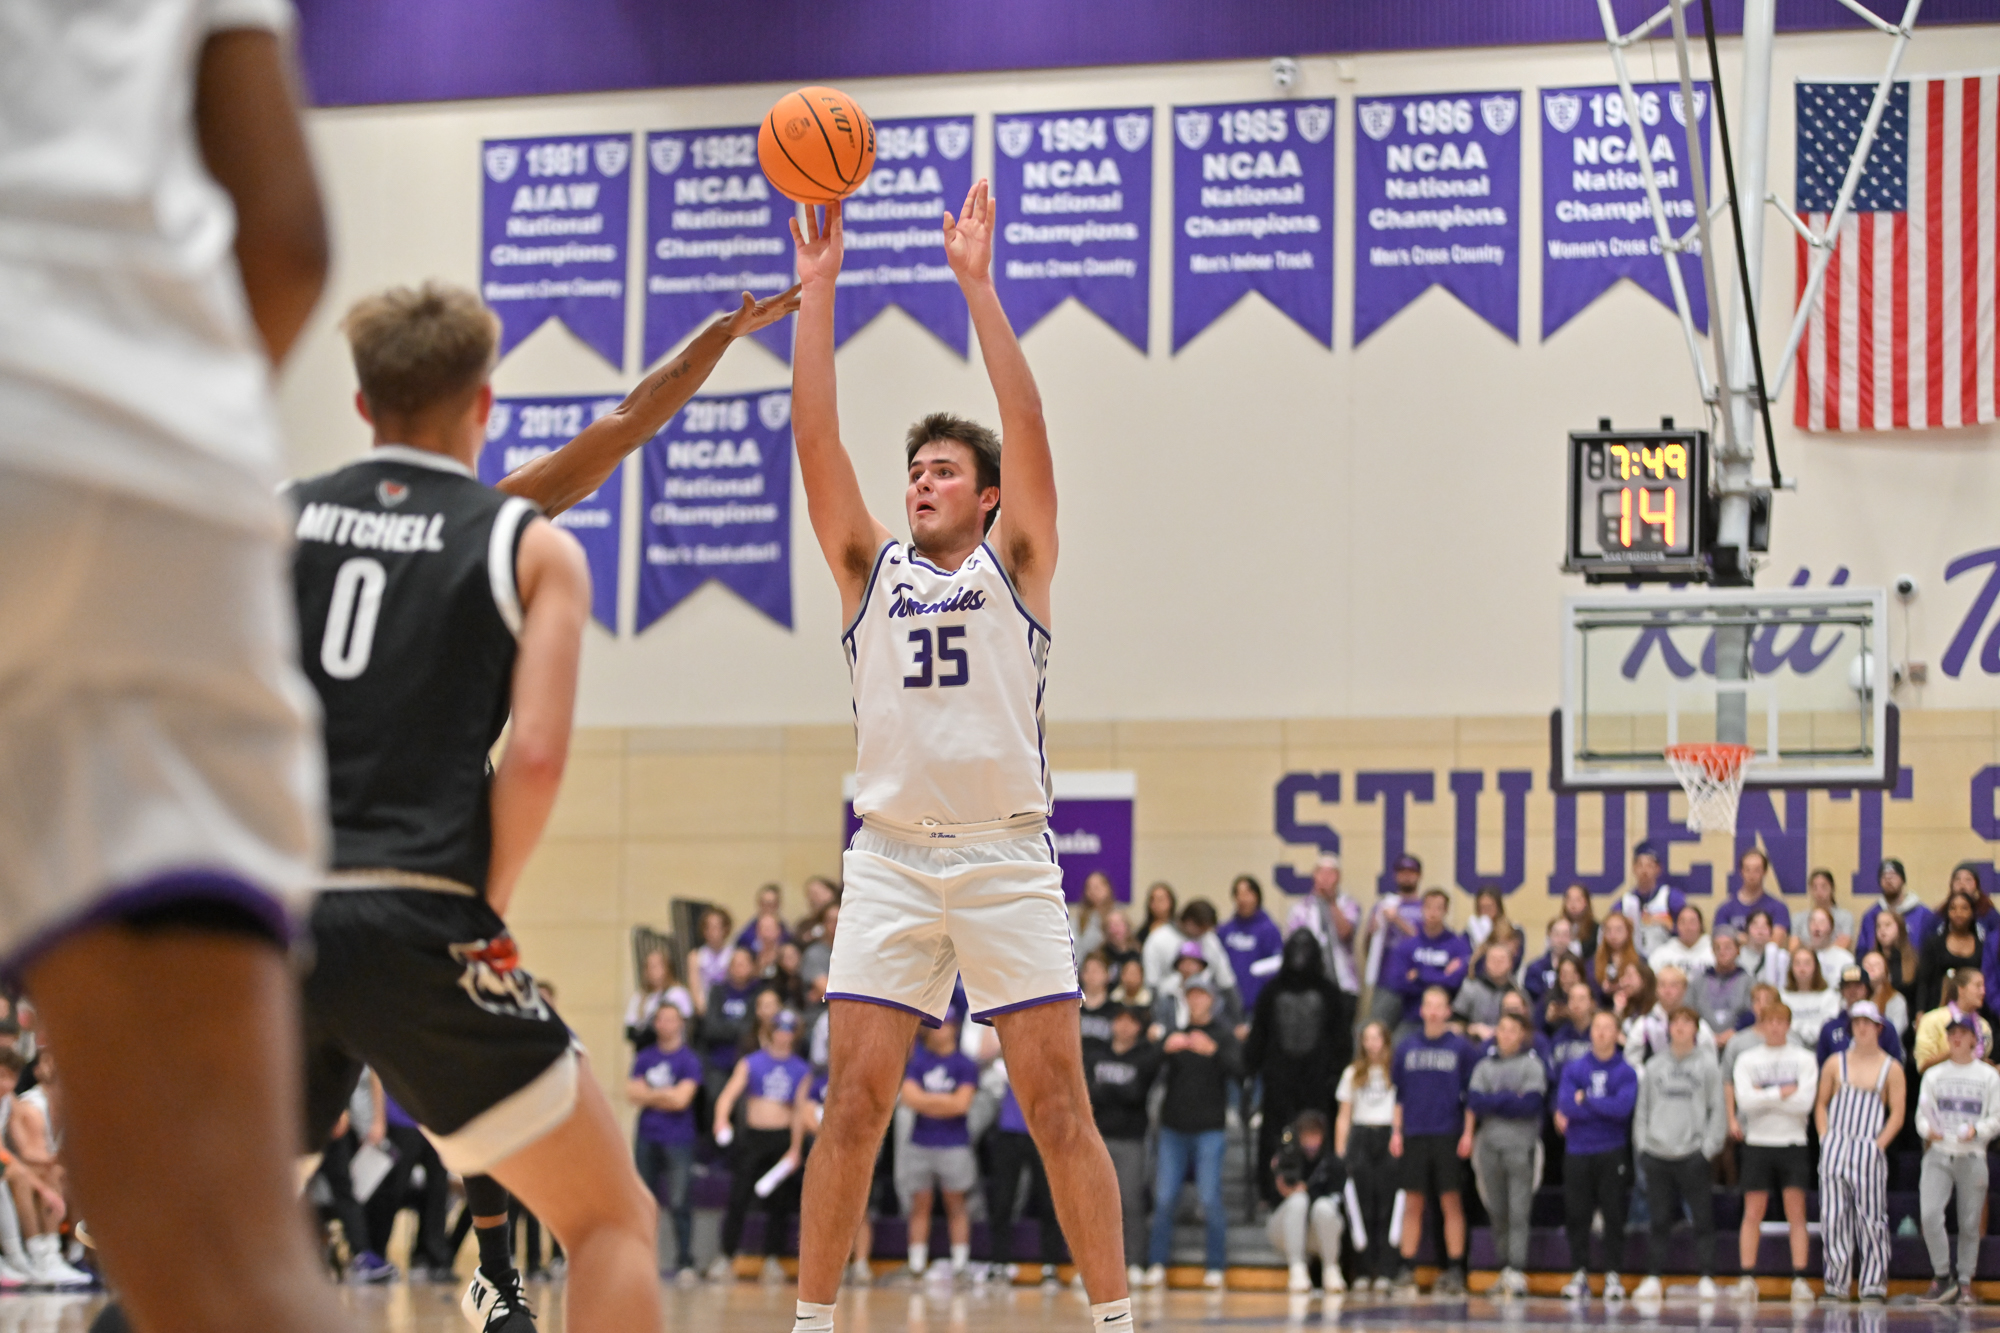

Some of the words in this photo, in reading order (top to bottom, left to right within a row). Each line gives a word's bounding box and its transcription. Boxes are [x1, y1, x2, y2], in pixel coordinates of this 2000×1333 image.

[1219, 108, 1288, 144] 1985
[1403, 100, 1474, 135] 1986
[874, 126, 929, 161] 984
[1039, 117, 1107, 153] 1984
[690, 134, 757, 169] 1982
[1203, 149, 1303, 182] NCAA
[1387, 141, 1488, 173] NCAA
[1022, 158, 1122, 189] NCAA
[1386, 174, 1491, 200] National
[1573, 166, 1679, 192] Natioal
[511, 182, 599, 213] AIAW
[674, 174, 770, 205] NCAA
[1021, 190, 1123, 215] National
[1201, 182, 1305, 208] National
[671, 206, 771, 231] National
[844, 197, 946, 222] National
[1369, 204, 1508, 232] Champions
[1556, 196, 1695, 224] Champins
[506, 213, 604, 238] National
[1004, 220, 1140, 247] Champions
[1184, 212, 1321, 240] Champions
[490, 242, 617, 267] Champions
[655, 236, 786, 261] Champions
[1411, 244, 1449, 265] Cross
[1450, 243, 1505, 266] Country
[1609, 236, 1649, 257] Cross
[519, 404, 583, 439] 2012
[682, 400, 749, 433] 2016
[667, 438, 762, 470] NCAA
[1610, 443, 1687, 481] 7:49
[664, 473, 765, 500] National
[296, 502, 445, 552] MITCHELL
[650, 501, 778, 528] Champions
[1620, 486, 1676, 548] 14
[320, 556, 387, 679] 0
[903, 624, 969, 688] 35
[1275, 770, 1913, 895] STUDENT
